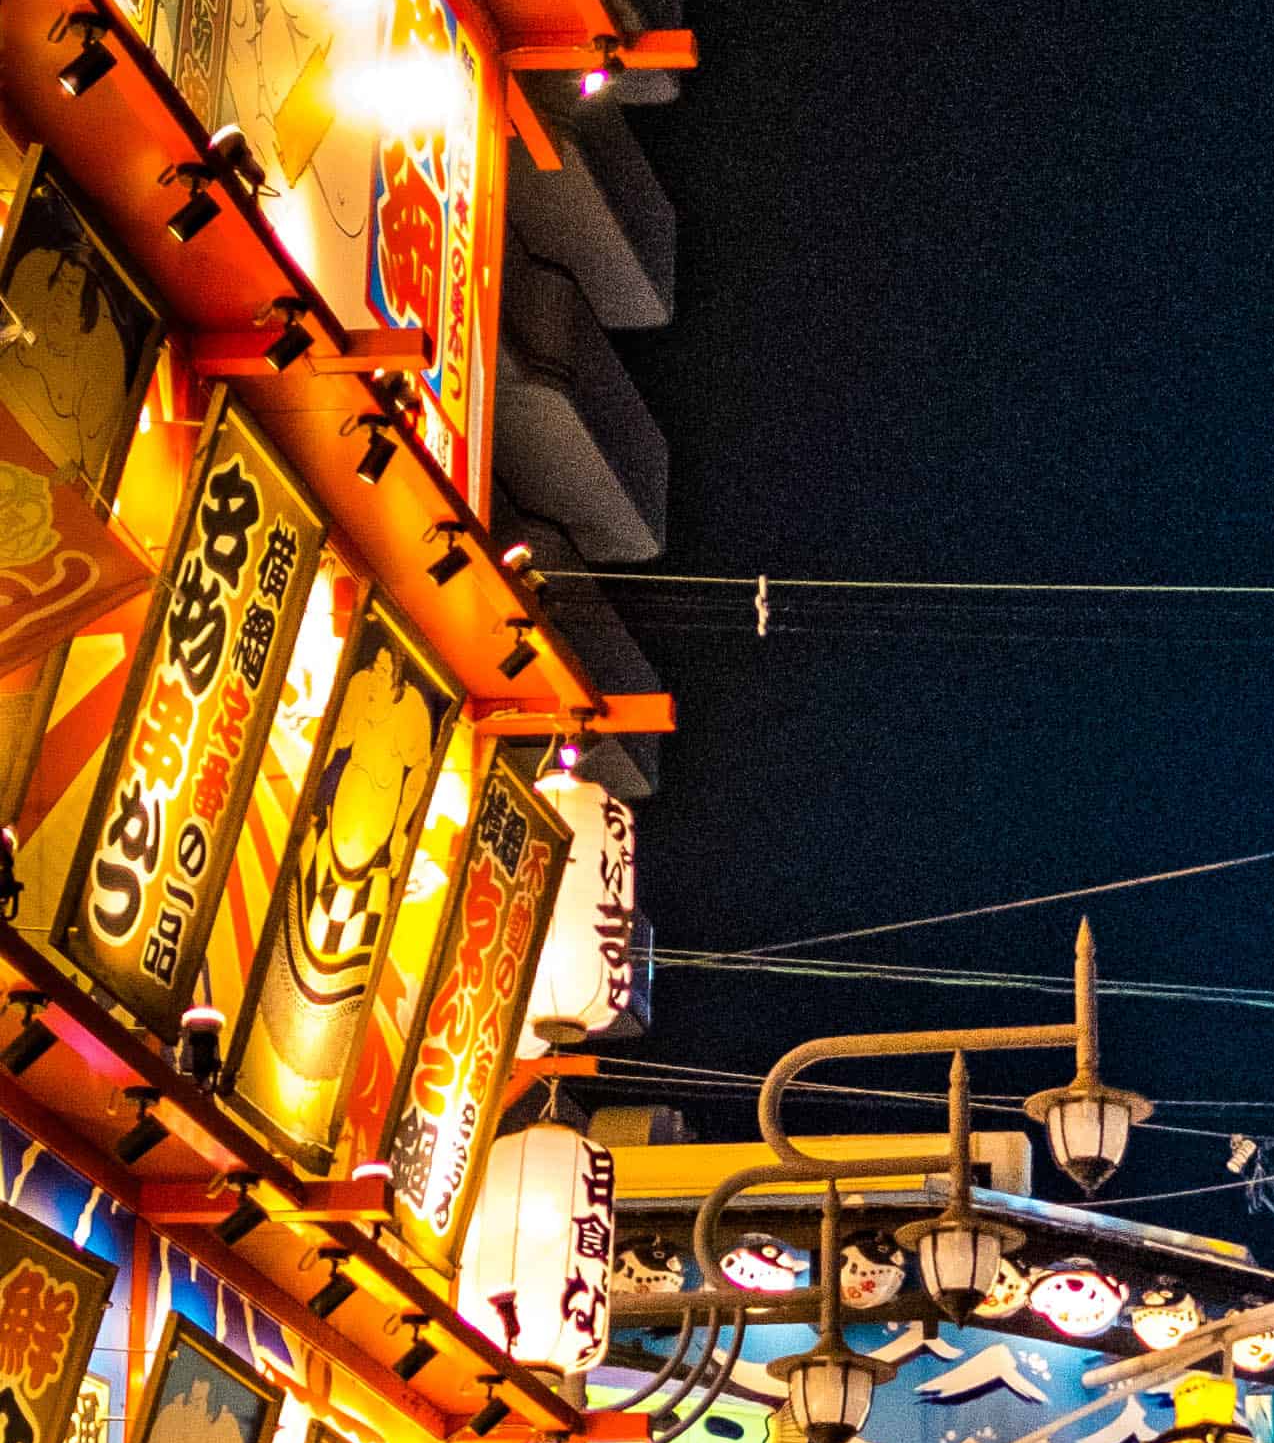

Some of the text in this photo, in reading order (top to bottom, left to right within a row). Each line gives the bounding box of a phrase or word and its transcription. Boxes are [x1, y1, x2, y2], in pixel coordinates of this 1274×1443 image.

[92, 457, 263, 946] 名物串かつ
